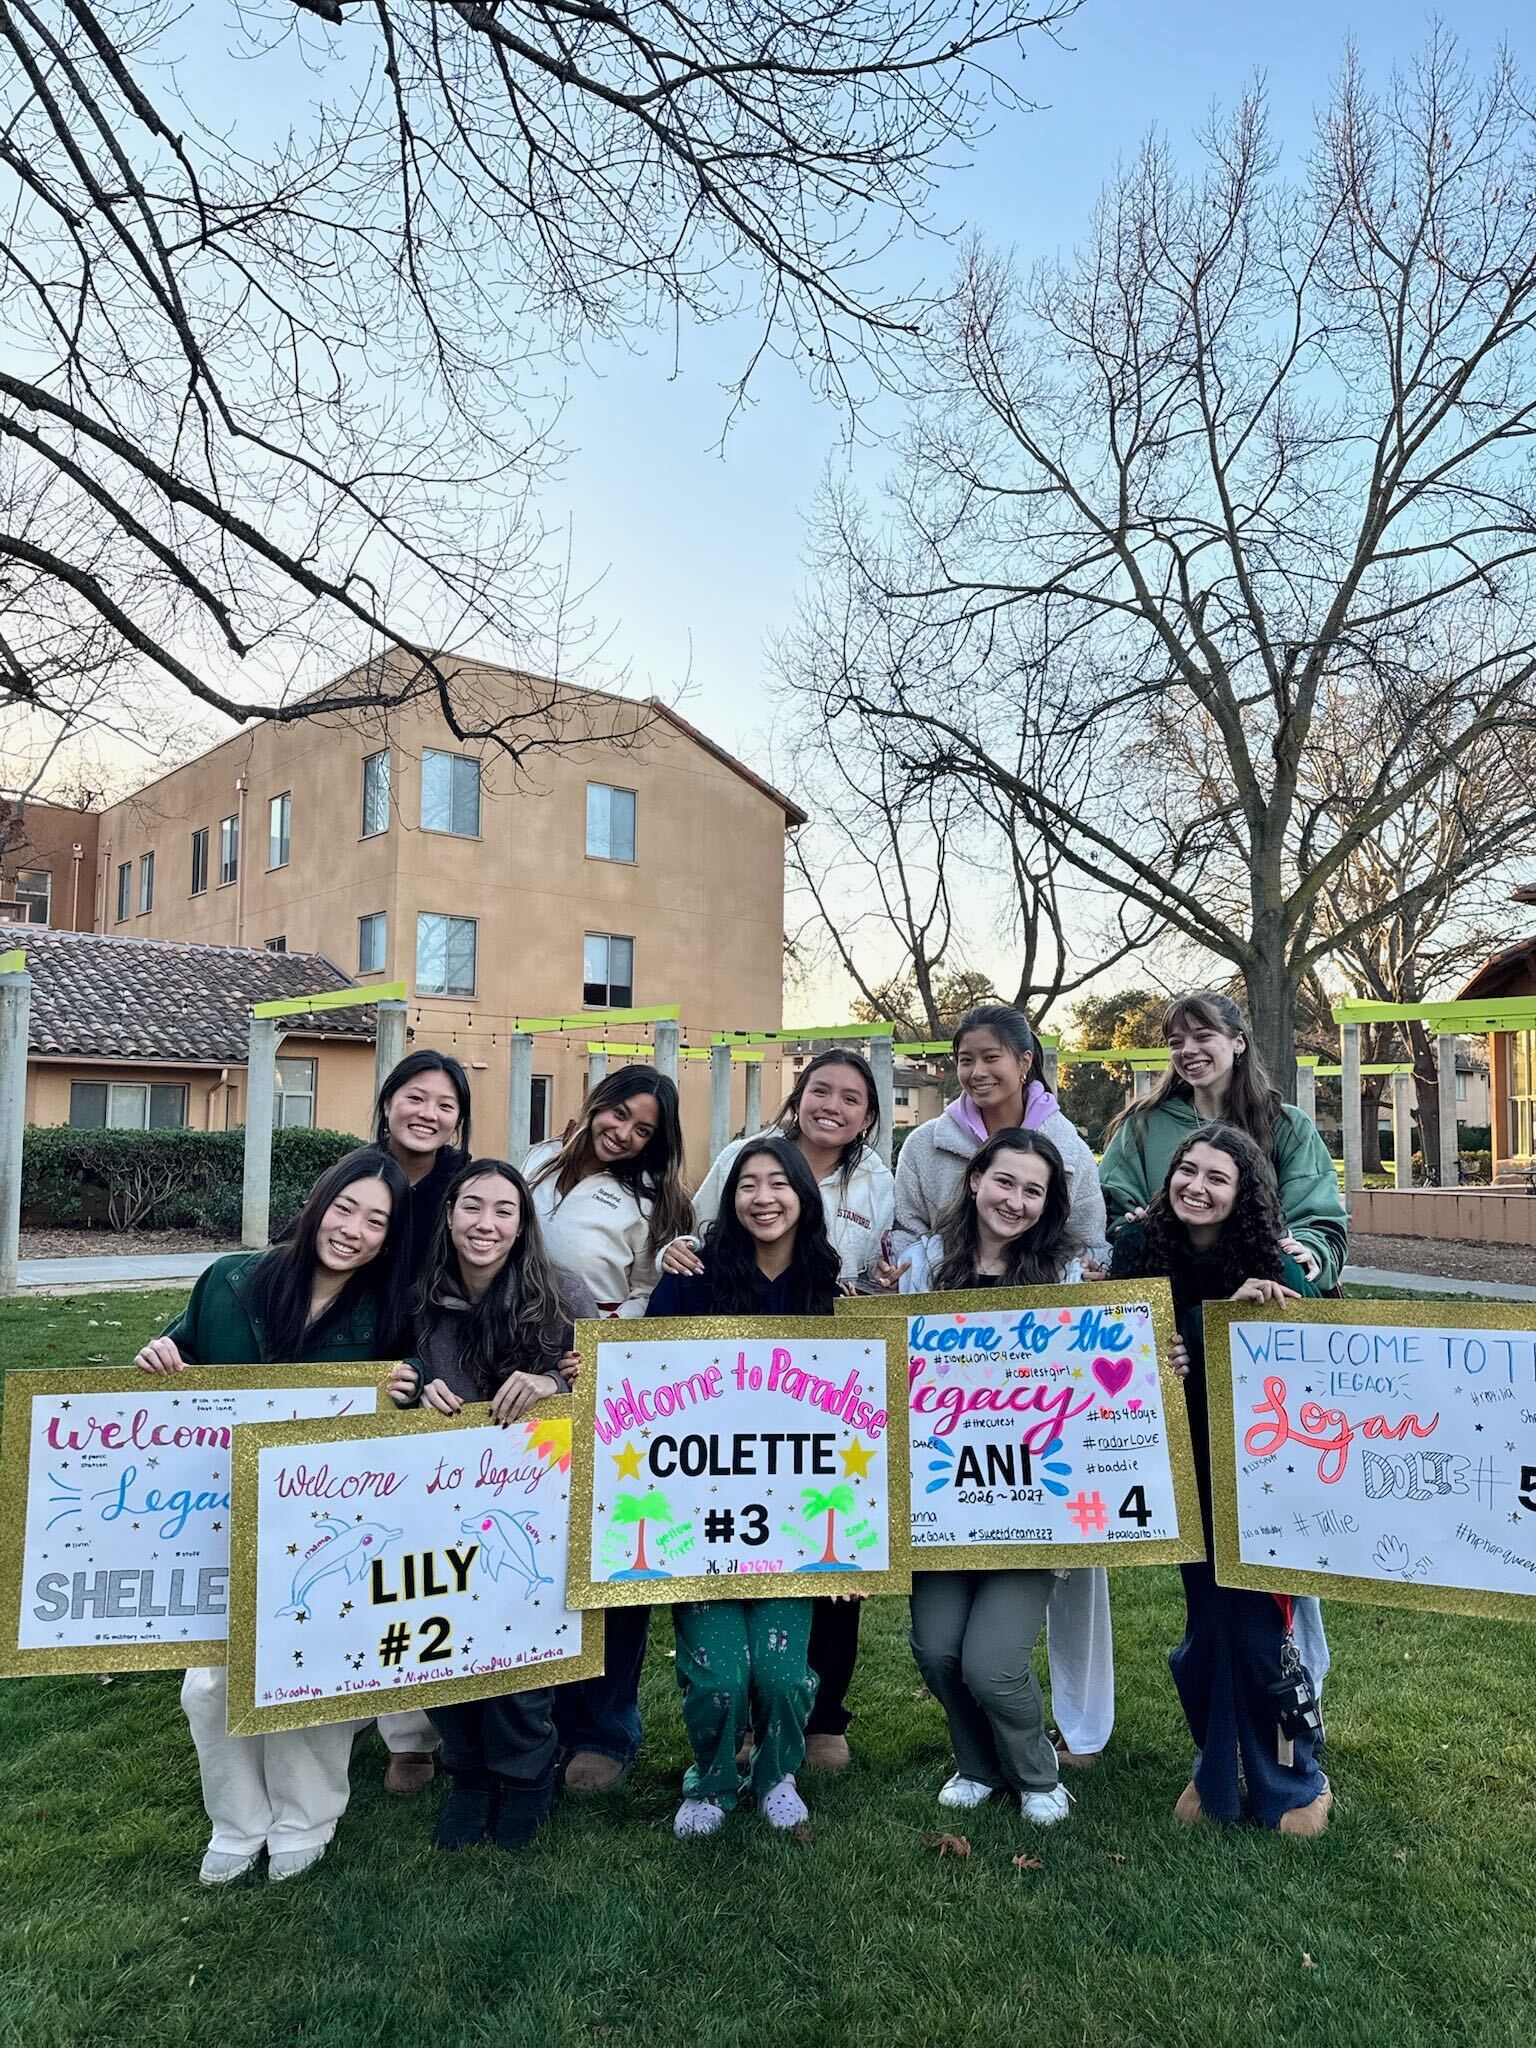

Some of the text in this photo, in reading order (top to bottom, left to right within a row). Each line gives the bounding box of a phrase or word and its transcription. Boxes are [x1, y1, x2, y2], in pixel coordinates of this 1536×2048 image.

[908, 1309, 1133, 1353] lcome to the
[1104, 1304, 1149, 1319] #sliving
[1237, 1326, 1424, 1366] WELCOME
[1439, 1336, 1486, 1375] TO
[1005, 1364, 1071, 1382] #coolestgirl
[1331, 1371, 1398, 1397] LEGACY
[593, 1348, 888, 1446] Welcome to Paradise
[42, 1409, 231, 1450] Welcom
[1244, 1376, 1439, 1484] Logan
[274, 1464, 408, 1498] Welcome
[426, 1456, 465, 1494] to
[649, 1433, 836, 1479] COLETTE
[955, 1443, 1033, 1488] ANI
[1086, 1459, 1139, 1474] #baddie
[90, 1465, 230, 1540] Lega
[525, 1521, 542, 1545] baby
[704, 1504, 770, 1546] #3
[304, 1535, 331, 1560] mama
[33, 1567, 228, 1622] SHELLE
[371, 1546, 479, 1605] LILY
[379, 1616, 453, 1667] #2
